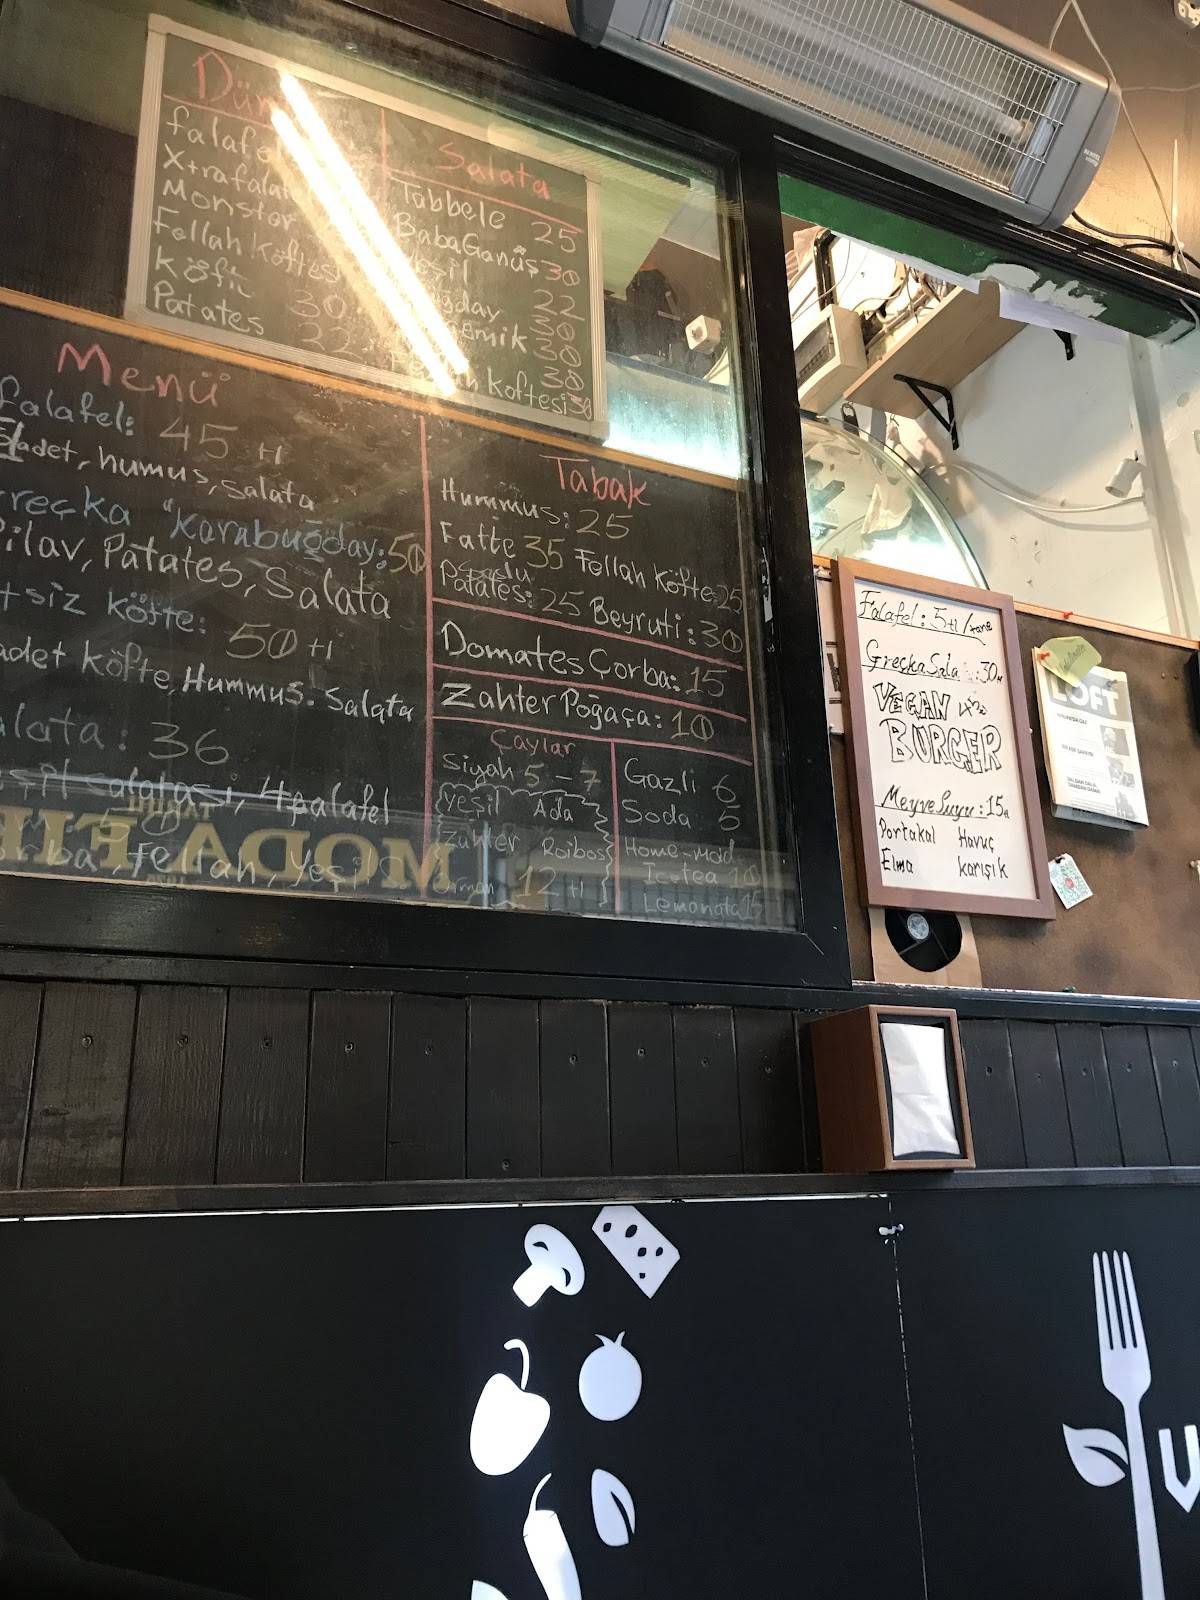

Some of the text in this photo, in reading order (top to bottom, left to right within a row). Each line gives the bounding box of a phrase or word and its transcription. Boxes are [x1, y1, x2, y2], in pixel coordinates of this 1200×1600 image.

[437, 142, 551, 200] Salata
[531, 221, 578, 254] 25
[541, 259, 581, 287] 30
[152, 280, 266, 336] Patates
[289, 289, 347, 319] 30
[535, 289, 586, 321] 22
[529, 314, 576, 342] 30
[534, 337, 582, 368] 30
[57, 341, 230, 408] Menü
[540, 366, 585, 392] 30
[159, 416, 240, 460] 45
[539, 454, 651, 510] Tabak
[576, 508, 633, 540] 25
[387, 532, 427, 576] 50
[440, 520, 517, 559] Fatte
[523, 534, 567, 571] 35
[265, 566, 392, 620] Salata
[540, 587, 585, 617] 25
[699, 619, 744, 654] 30
[226, 622, 299, 660] 50
[440, 619, 728, 698] Domates Çorba: 15
[324, 685, 415, 726] Salata
[440, 681, 557, 716] Zahter
[670, 709, 715, 742] 10
[872, 681, 952, 721] VEGAN
[148, 721, 230, 767] 36
[489, 728, 577, 758] Çaylar
[878, 717, 1003, 775] BURGER
[442, 752, 516, 784] Siyah
[524, 762, 546, 789] 5
[579, 768, 602, 793] 7
[711, 774, 738, 804] 6
[532, 798, 574, 823] Ada
[621, 799, 743, 832] Soda 5
[879, 817, 995, 854] Portakal Havuç
[880, 847, 914, 874] Elma
[514, 864, 560, 898] 12
